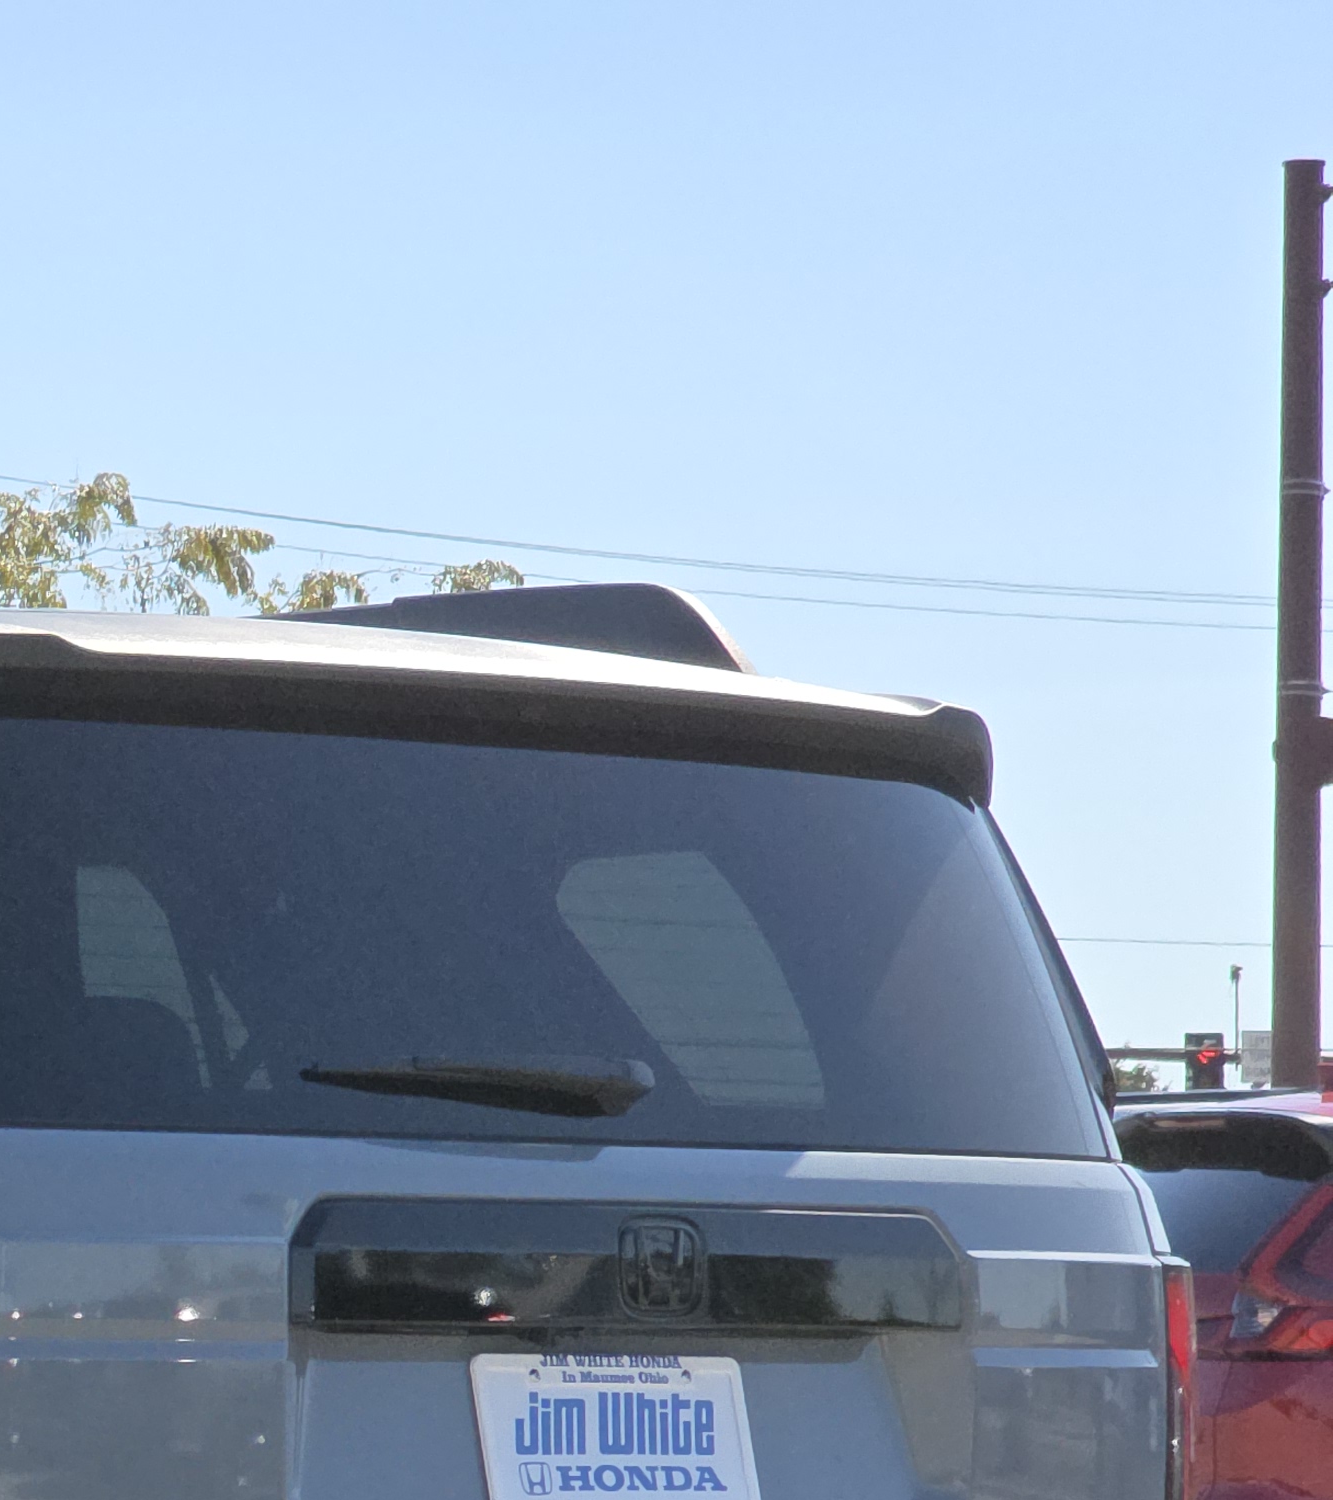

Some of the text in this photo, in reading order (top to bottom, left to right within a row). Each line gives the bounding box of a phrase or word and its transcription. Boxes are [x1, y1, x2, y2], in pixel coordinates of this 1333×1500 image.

[540, 1353, 682, 1369] JIM WHITE HONDA
[598, 1391, 715, 1456] White
[555, 1464, 728, 1492] HONDA
